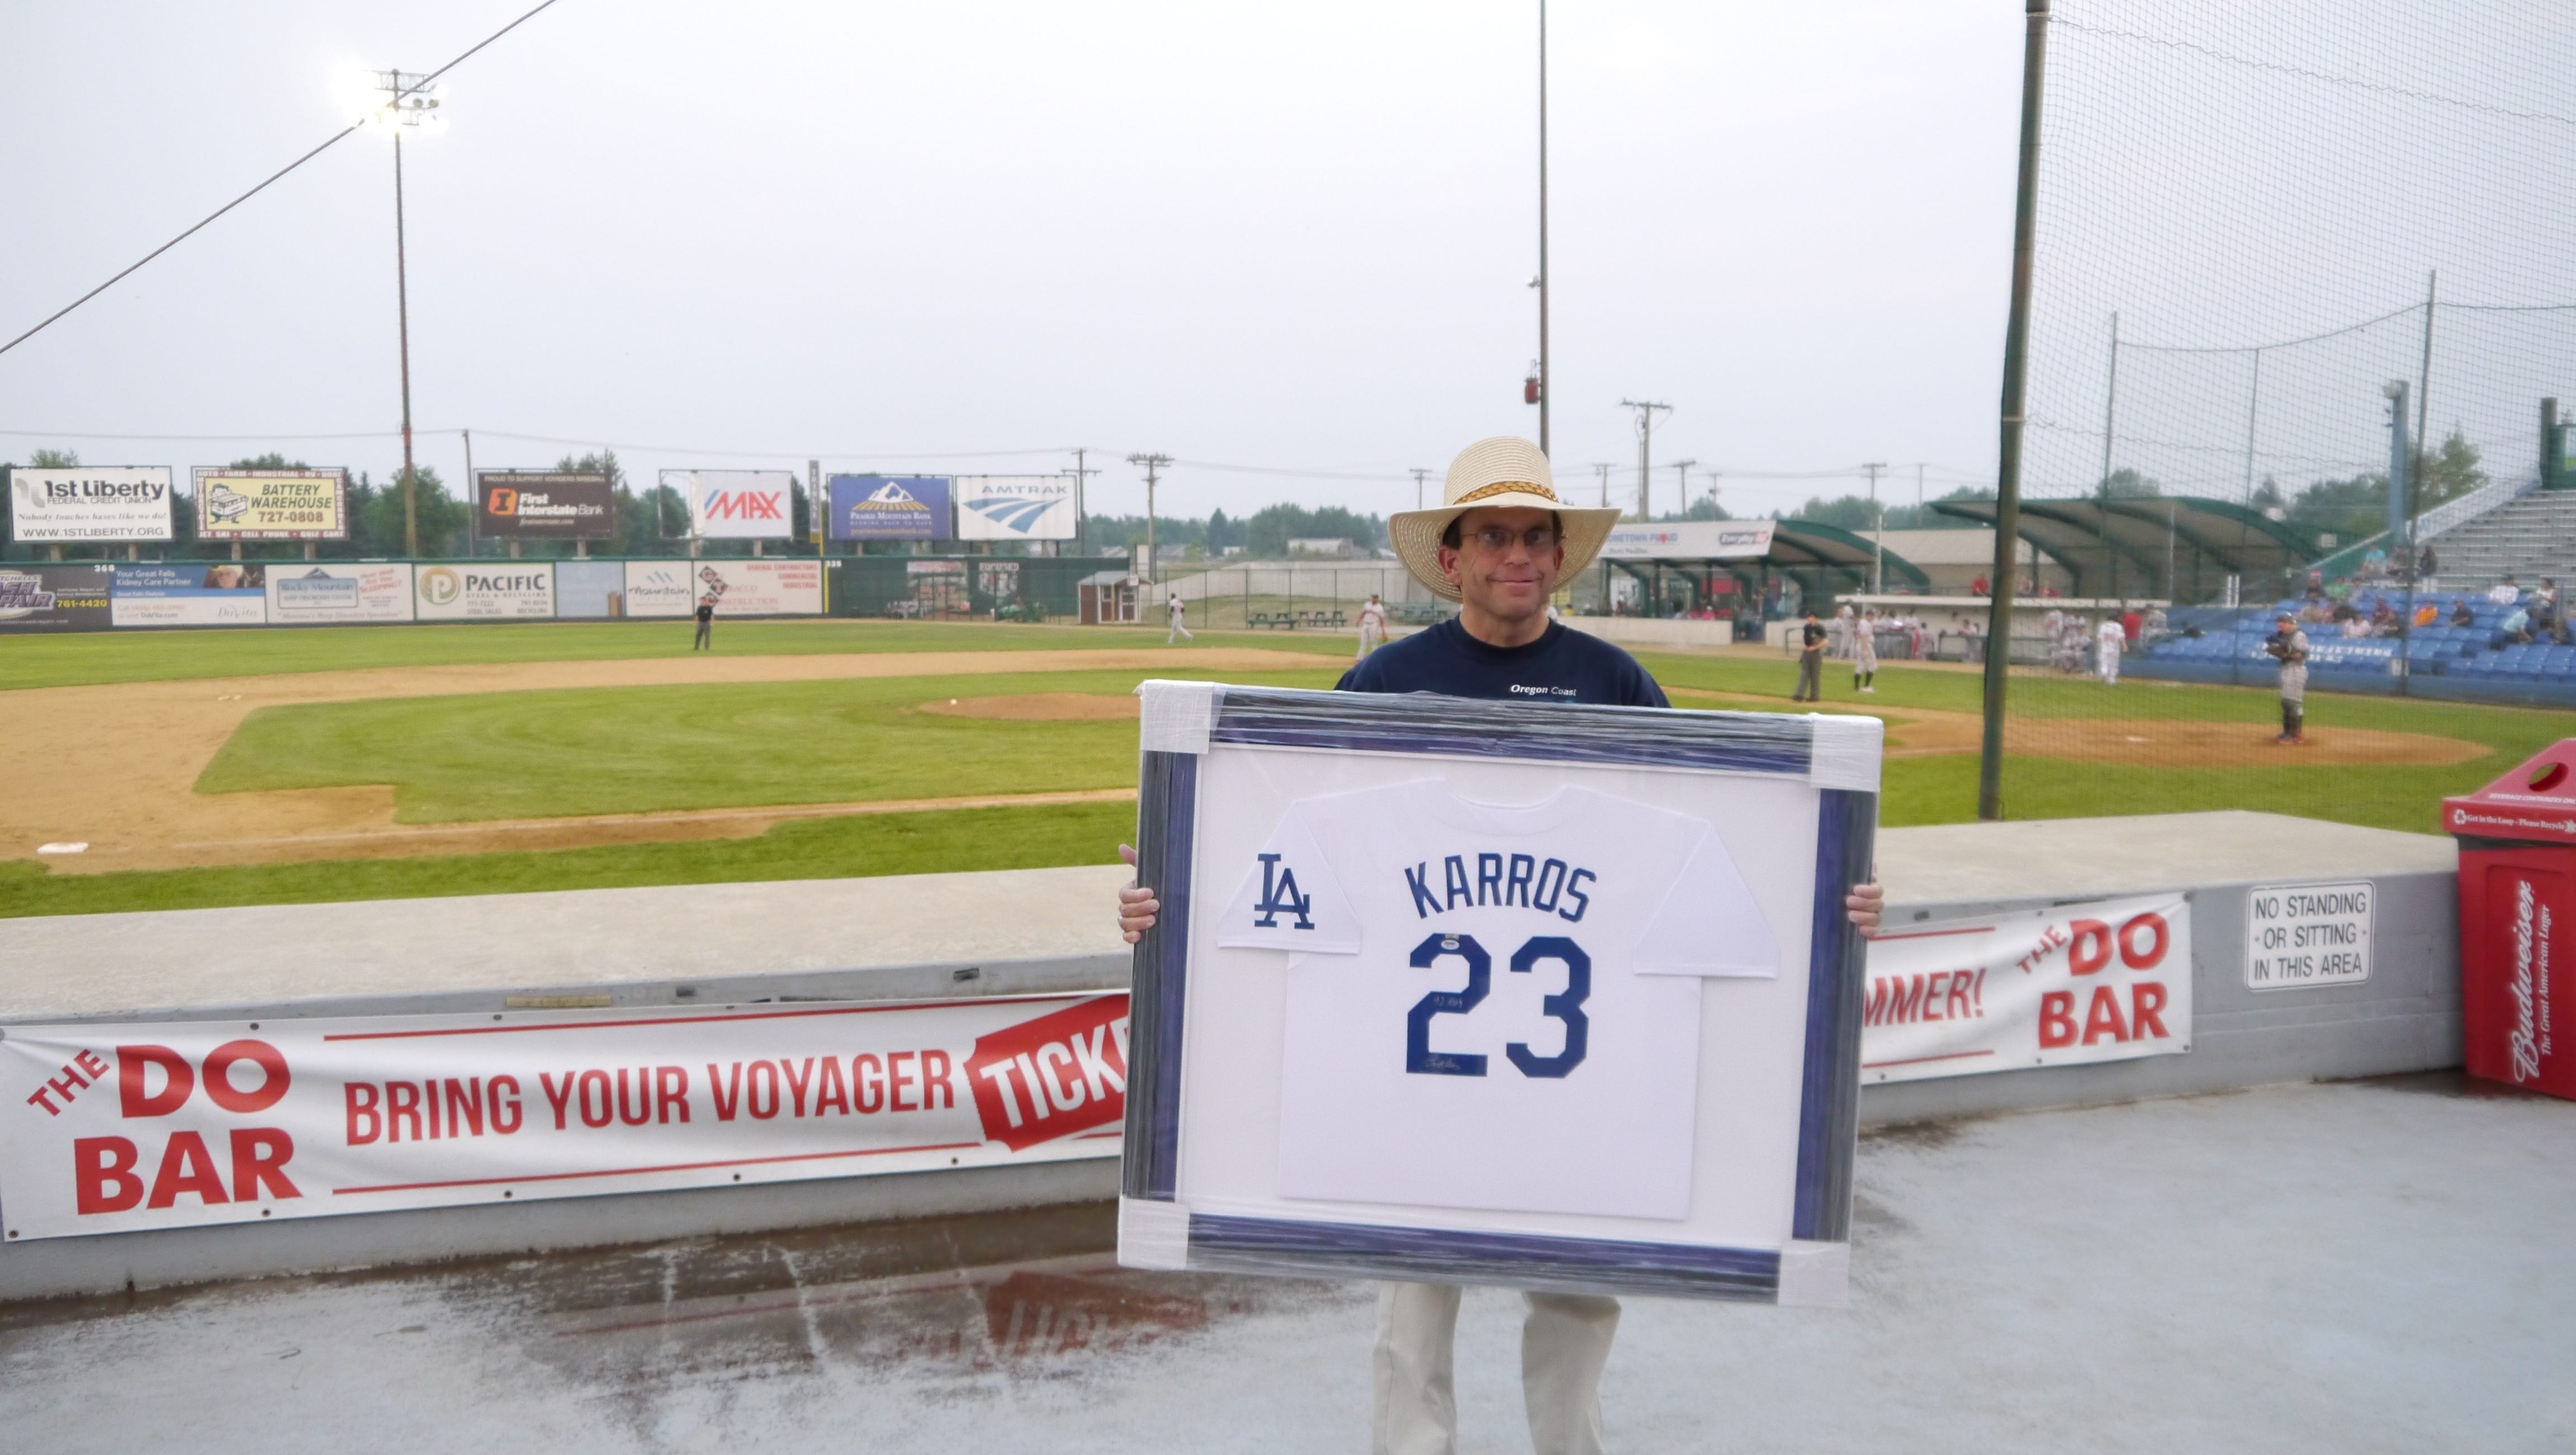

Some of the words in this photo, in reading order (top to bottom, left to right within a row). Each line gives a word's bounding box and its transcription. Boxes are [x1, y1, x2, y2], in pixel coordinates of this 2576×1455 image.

[45, 480, 77, 497] 1st
[82, 480, 164, 500] Liberty
[262, 484, 320, 496] BATTERY
[519, 493, 550, 504] First
[982, 485, 1067, 494] AMTRAK
[251, 497, 333, 509] WAREHOUSE
[518, 504, 577, 515] Interstate
[578, 504, 603, 515] Bank
[18, 513, 53, 522] Nobody
[258, 511, 324, 523] 727-0808
[913, 511, 931, 519] BANK
[22, 527, 164, 537] WWW.1STLIBERTY.ORG
[465, 574, 546, 591] PACIFIC
[56, 599, 107, 608] 761-4420
[1510, 684, 1548, 695] Oregon
[1551, 686, 1578, 696] Coast
[2498, 817, 2515, 826] Loop
[2520, 818, 2540, 827] Please
[2541, 820, 2565, 830] Recycle
[1404, 852, 1598, 923] KARROS
[2255, 897, 2279, 920] NO
[2286, 892, 2366, 918] STANDING
[2538, 904, 2552, 941] Lager
[2016, 925, 2069, 976] THE
[2068, 911, 2170, 977] DO
[2264, 927, 2287, 950] OR
[2294, 922, 2356, 947] SITTING
[2255, 959, 2270, 980] IN
[2277, 955, 2313, 979] THIS
[2320, 952, 2362, 975] AREA
[2538, 944, 2551, 997] American
[2511, 880, 2540, 1083] Budweiser
[1405, 932, 1592, 1079] 23
[2540, 998, 2551, 1030] Great
[2038, 982, 2171, 1050] BAR
[2541, 1037, 2551, 1056] The
[26, 1049, 110, 1117] THE
[116, 1039, 292, 1118] DO
[344, 1074, 523, 1146] BRING
[539, 1065, 691, 1130] YOUR
[707, 1049, 954, 1121] VOYAGER
[74, 1127, 304, 1216] BAR
